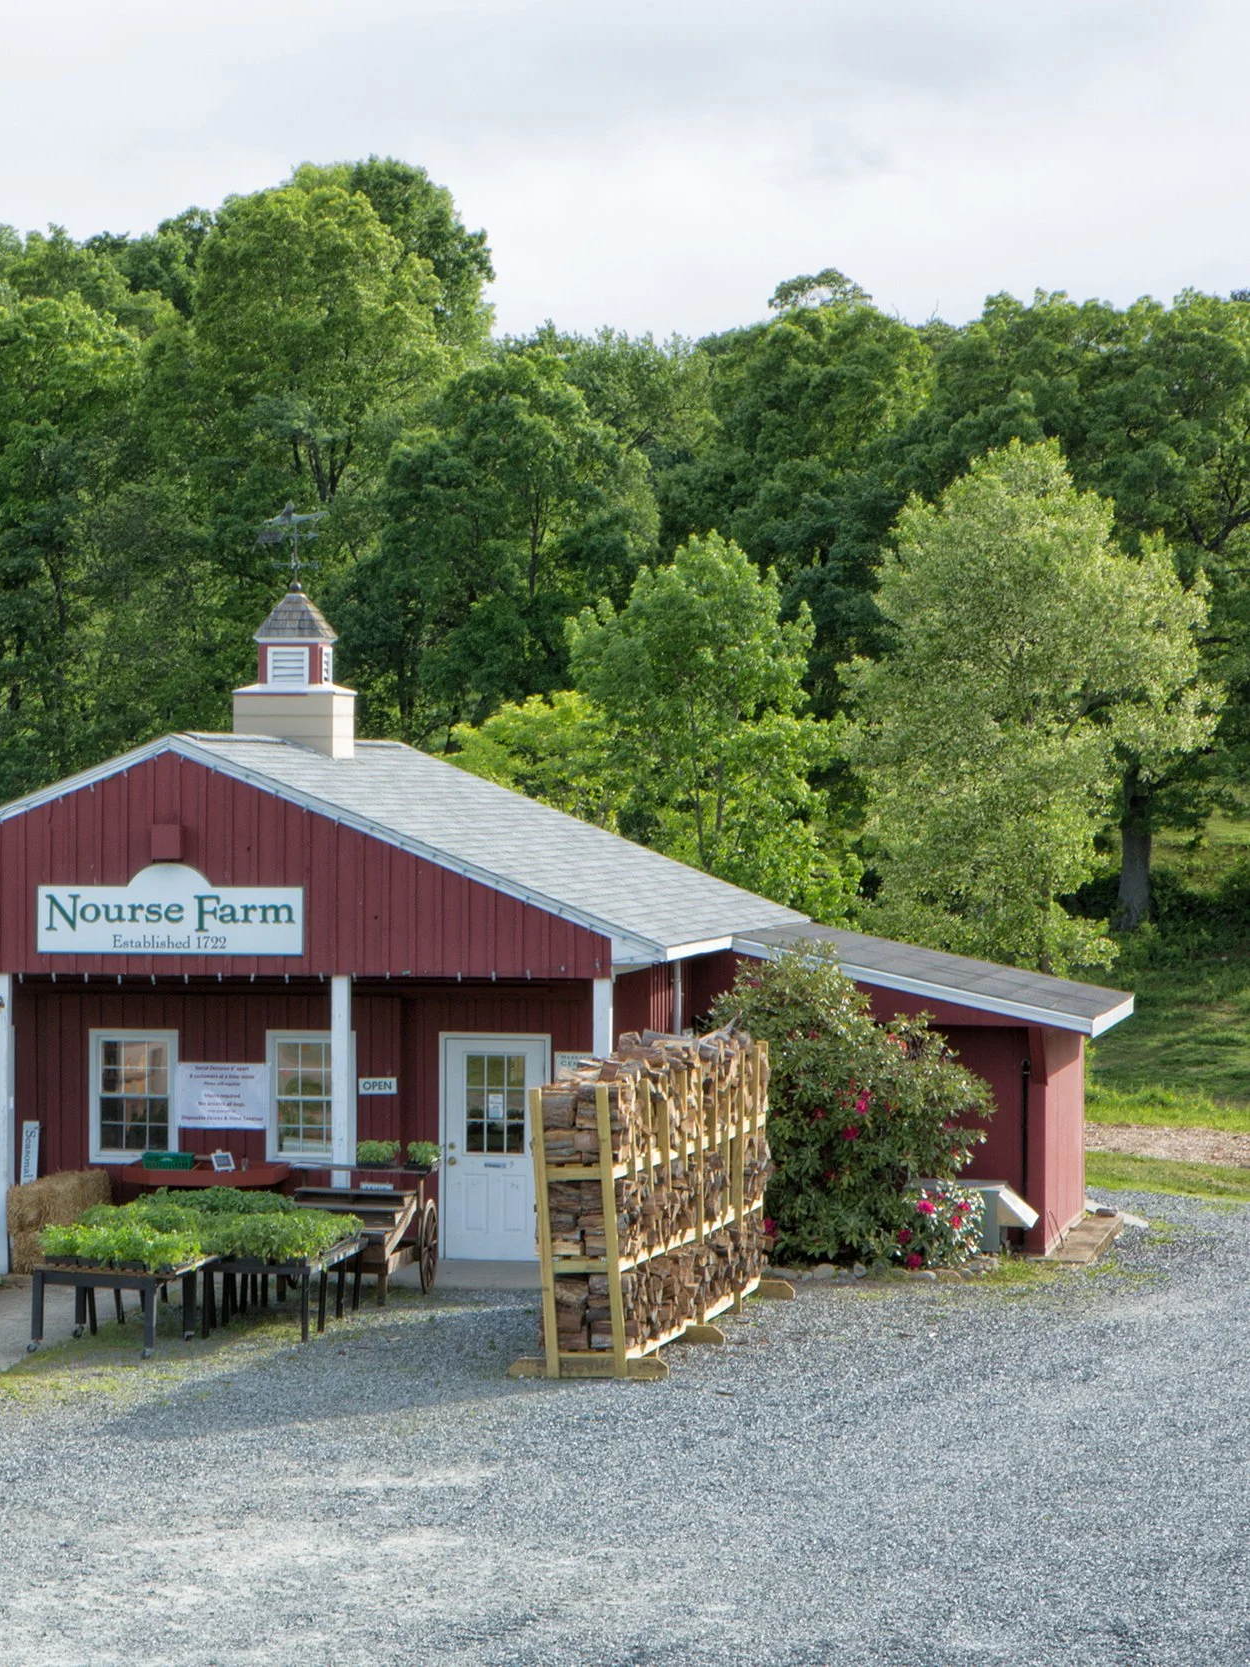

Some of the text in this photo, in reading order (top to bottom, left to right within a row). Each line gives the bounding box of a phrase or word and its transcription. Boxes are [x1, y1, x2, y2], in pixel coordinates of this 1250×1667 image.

[45, 893, 296, 933] Nourse Farm
[112, 934, 227, 950] Established 1722
[362, 1080, 392, 1091] OPEN
[23, 1130, 37, 1178] Seasonal
